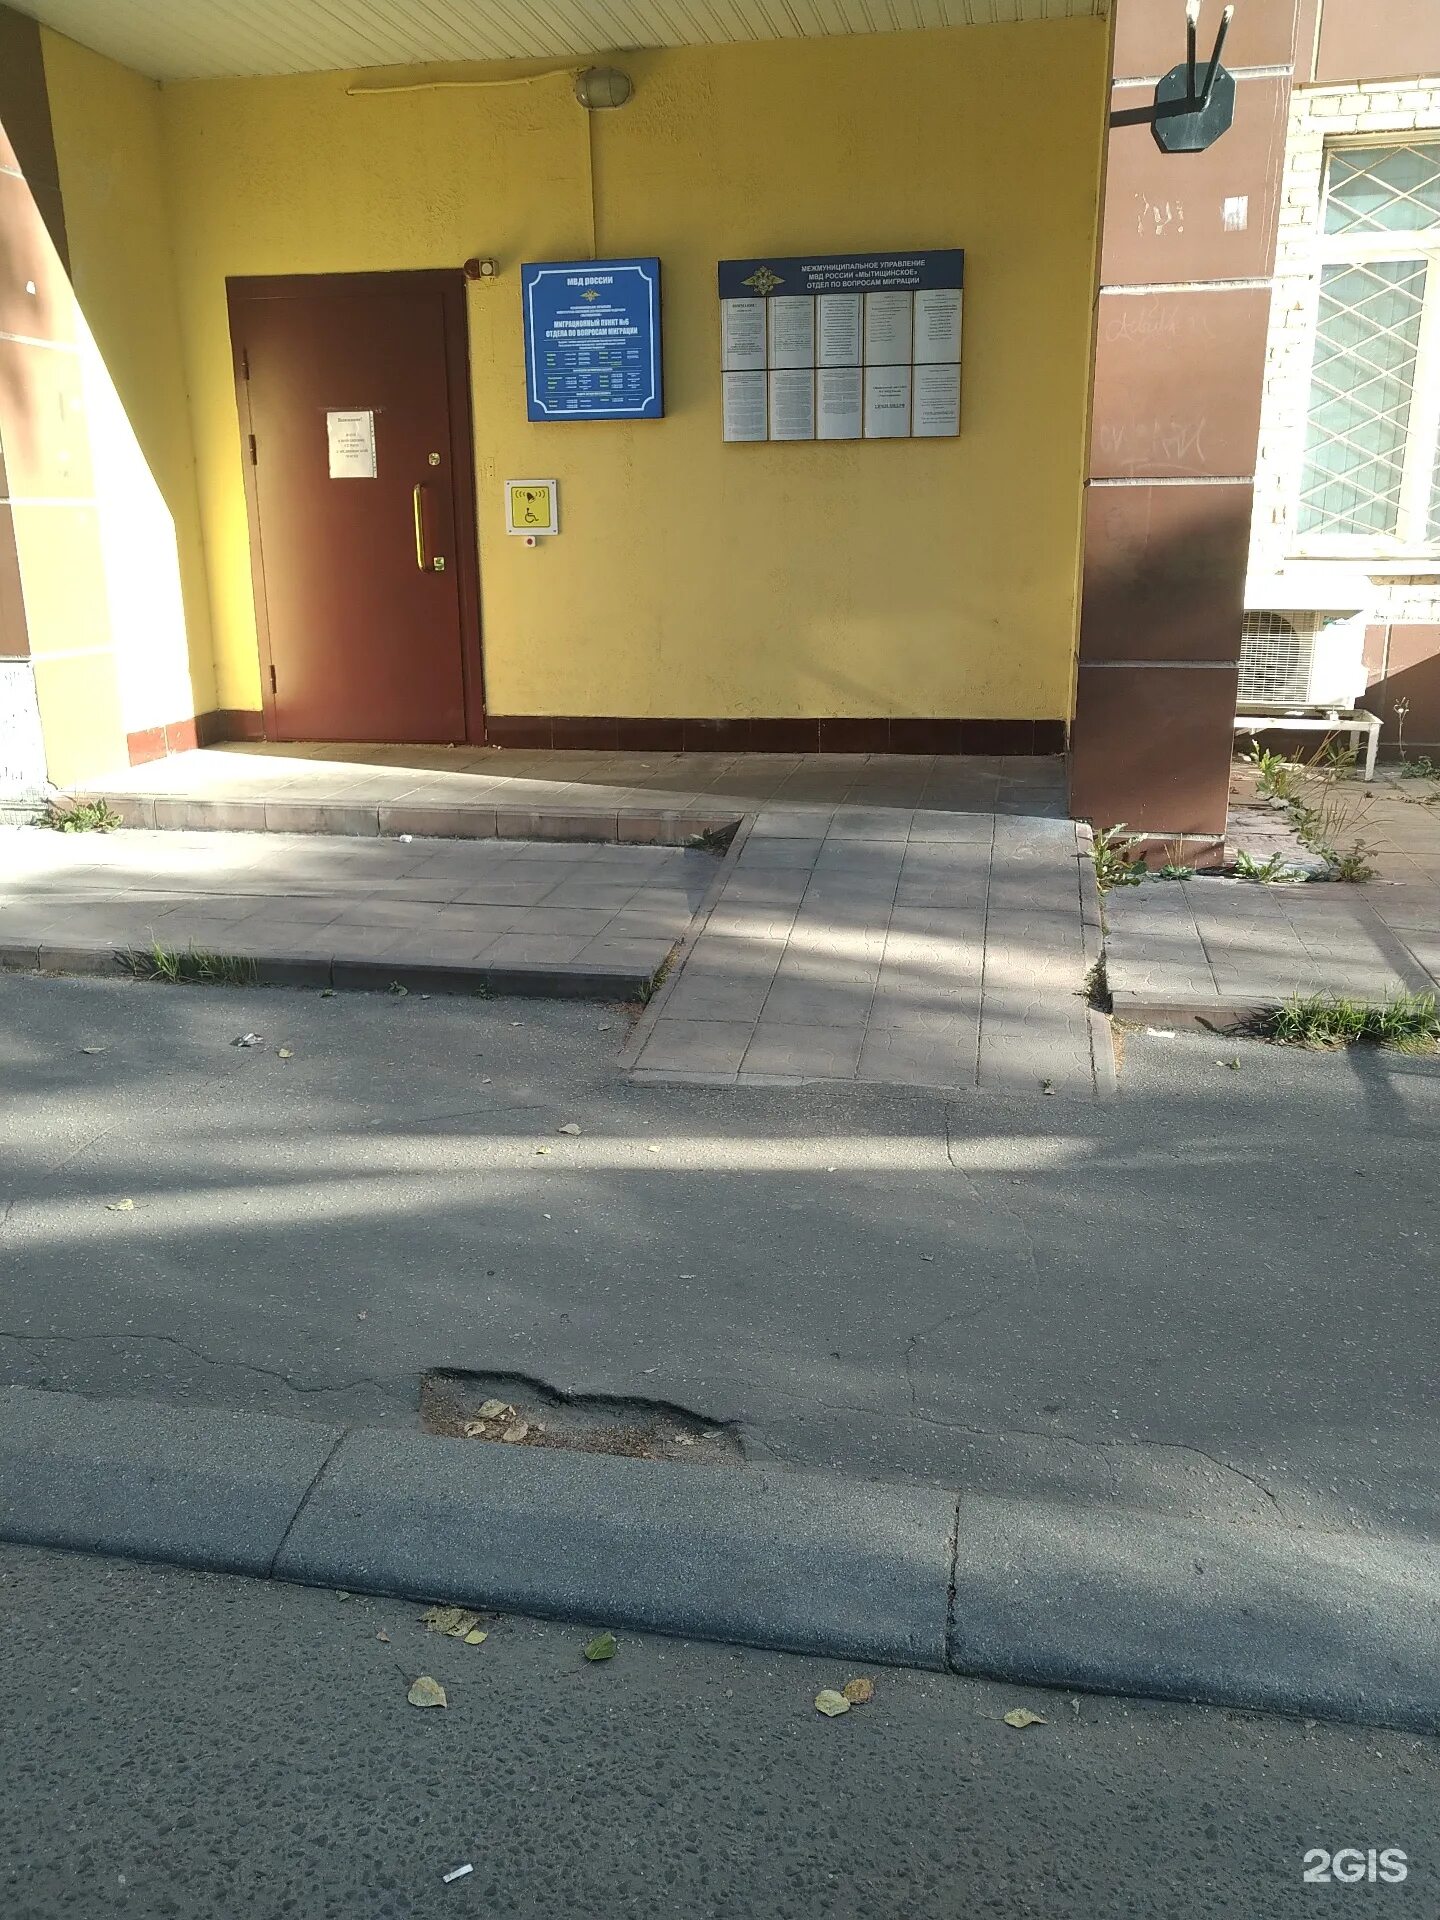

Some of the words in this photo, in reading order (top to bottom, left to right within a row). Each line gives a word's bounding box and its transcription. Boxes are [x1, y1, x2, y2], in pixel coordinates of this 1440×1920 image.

[801, 262, 879, 272] МЕЖМУНИЦИПАЛЬНОЕ
[880, 259, 926, 268] УПРАВЛЕНИЕ
[808, 273, 824, 281] МВД
[825, 271, 854, 280] РОССИИ
[855, 269, 918, 279] «МЫТИЩИНСКОЕ»
[567, 278, 584, 287] МВД
[585, 276, 613, 286] РОССИИ
[806, 281, 830, 290] ОТДЕЛ
[831, 280, 841, 288] ПО
[842, 278, 881, 287] ВОПРОСАМ
[882, 276, 920, 286] МИГРАЦИИ
[554, 319, 600, 329] МИГРАЦИОННЫЙ
[545, 329, 568, 339] ОТДЕЛА
[568, 329, 576, 337] ПО
[577, 328, 607, 337] ВОПРОСАМ
[608, 327, 638, 336] МИГРАЦИИ
